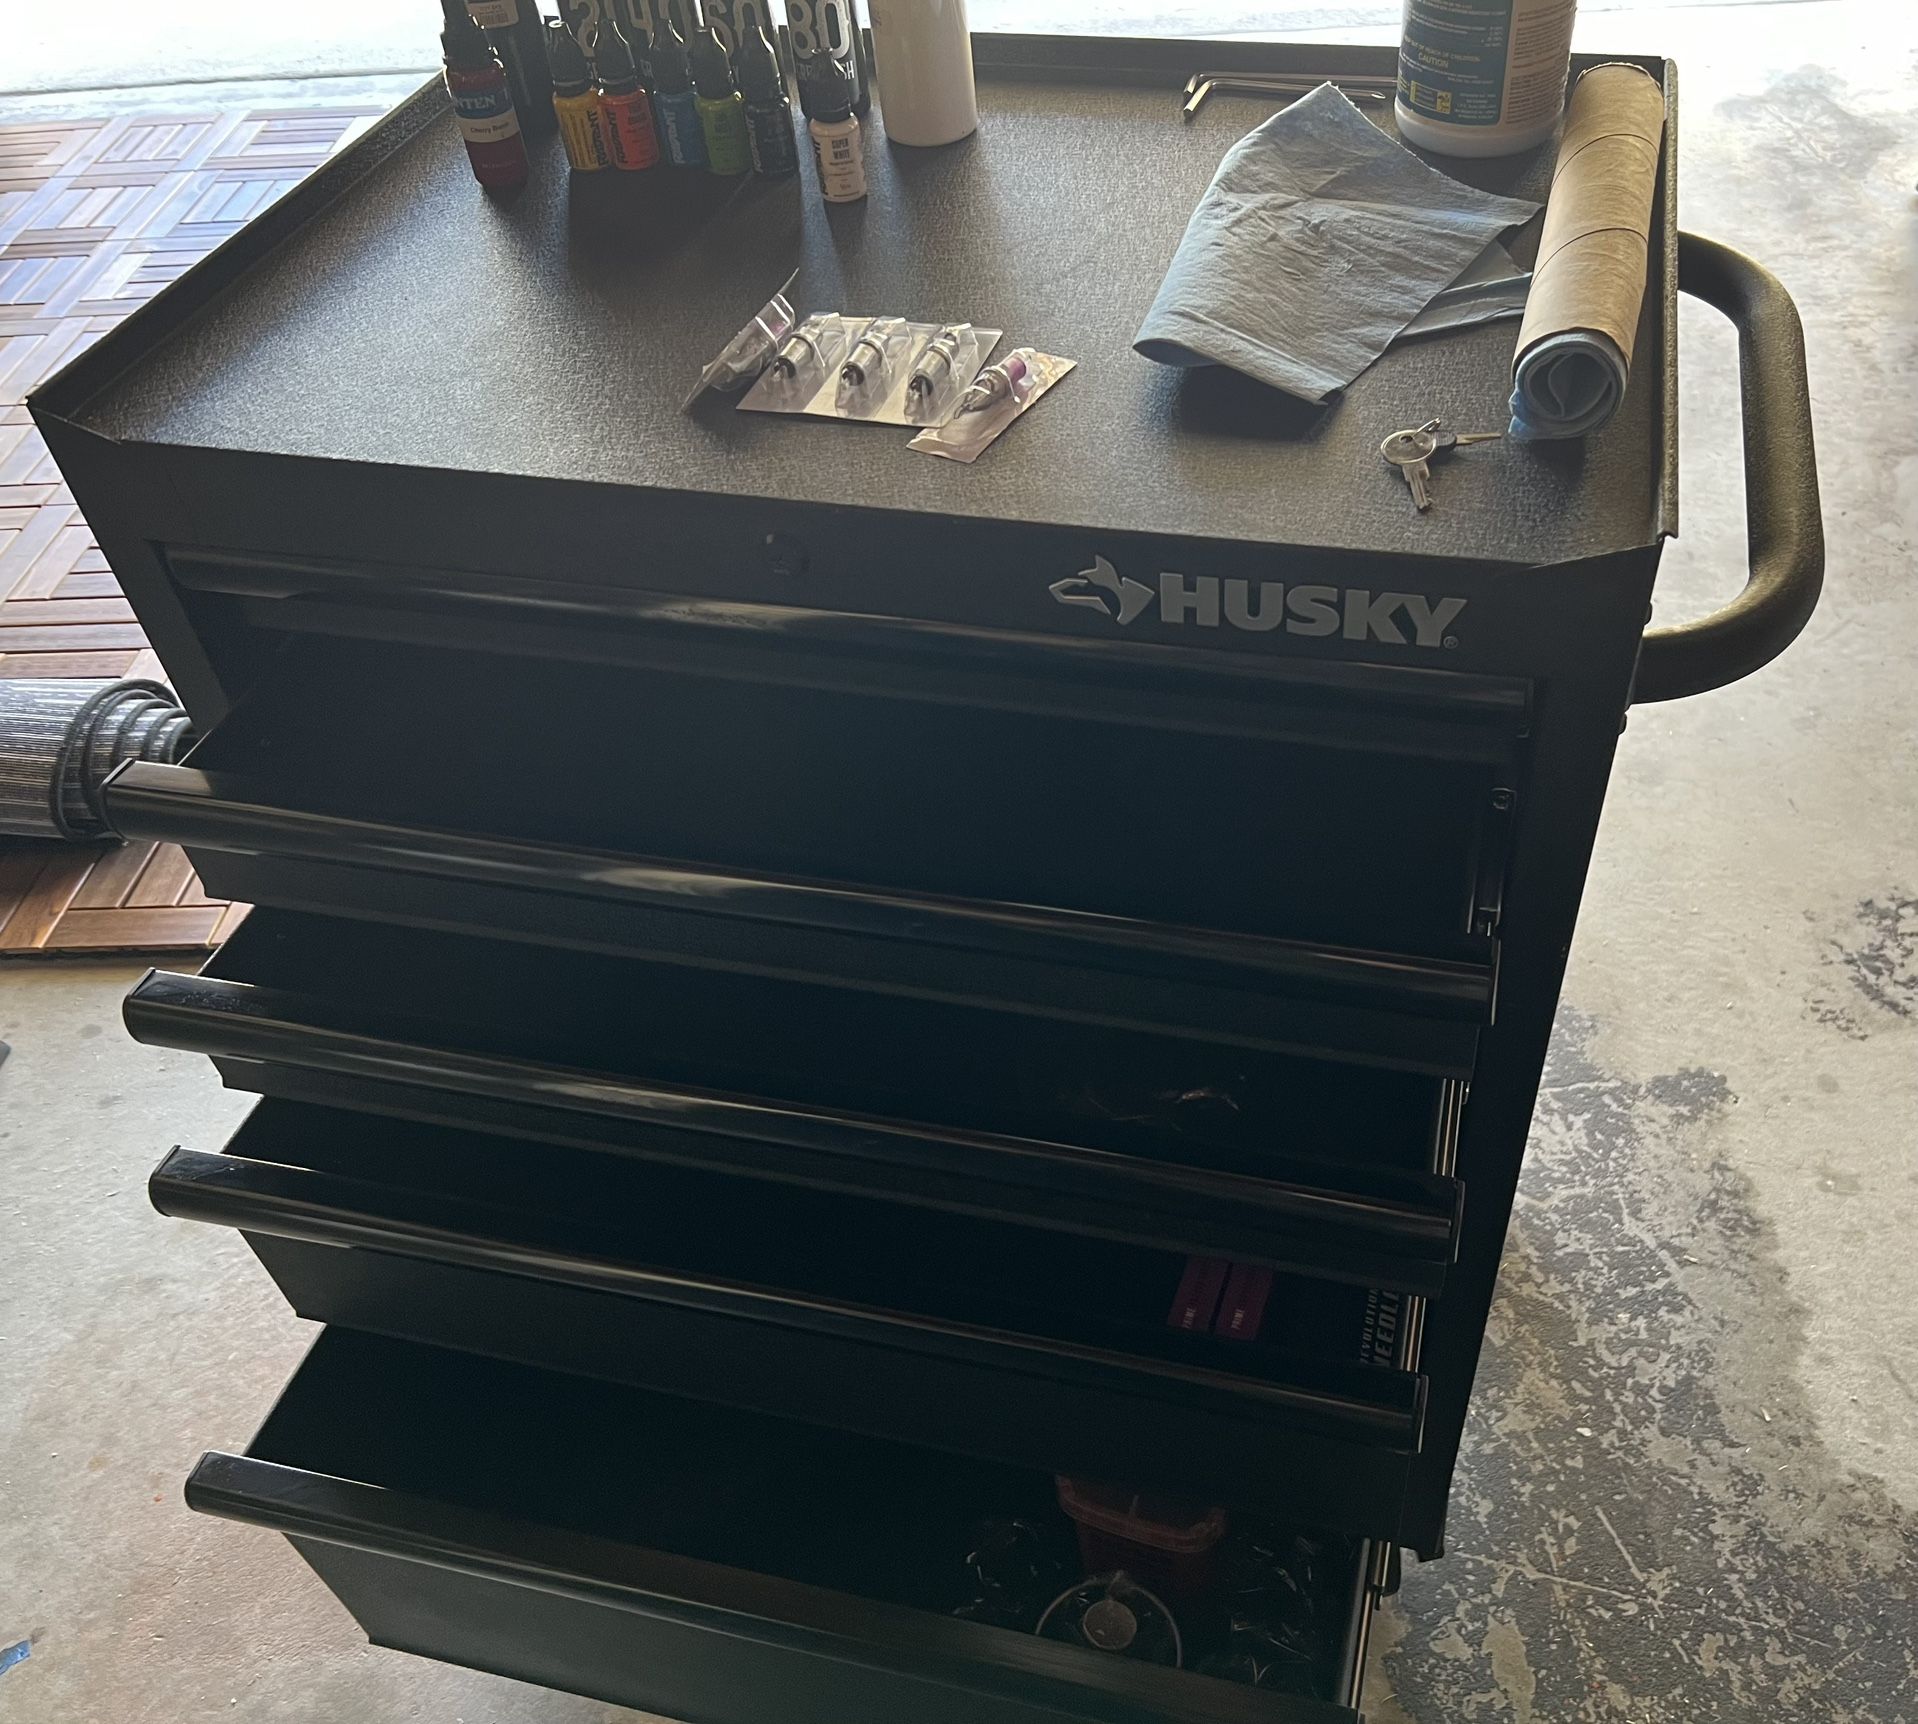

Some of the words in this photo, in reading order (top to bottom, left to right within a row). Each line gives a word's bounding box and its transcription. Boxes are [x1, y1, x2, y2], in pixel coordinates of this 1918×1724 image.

[788, 0, 851, 59] 80
[1418, 52, 1449, 68] CAUTION
[1159, 572, 1467, 648] HUSKY
